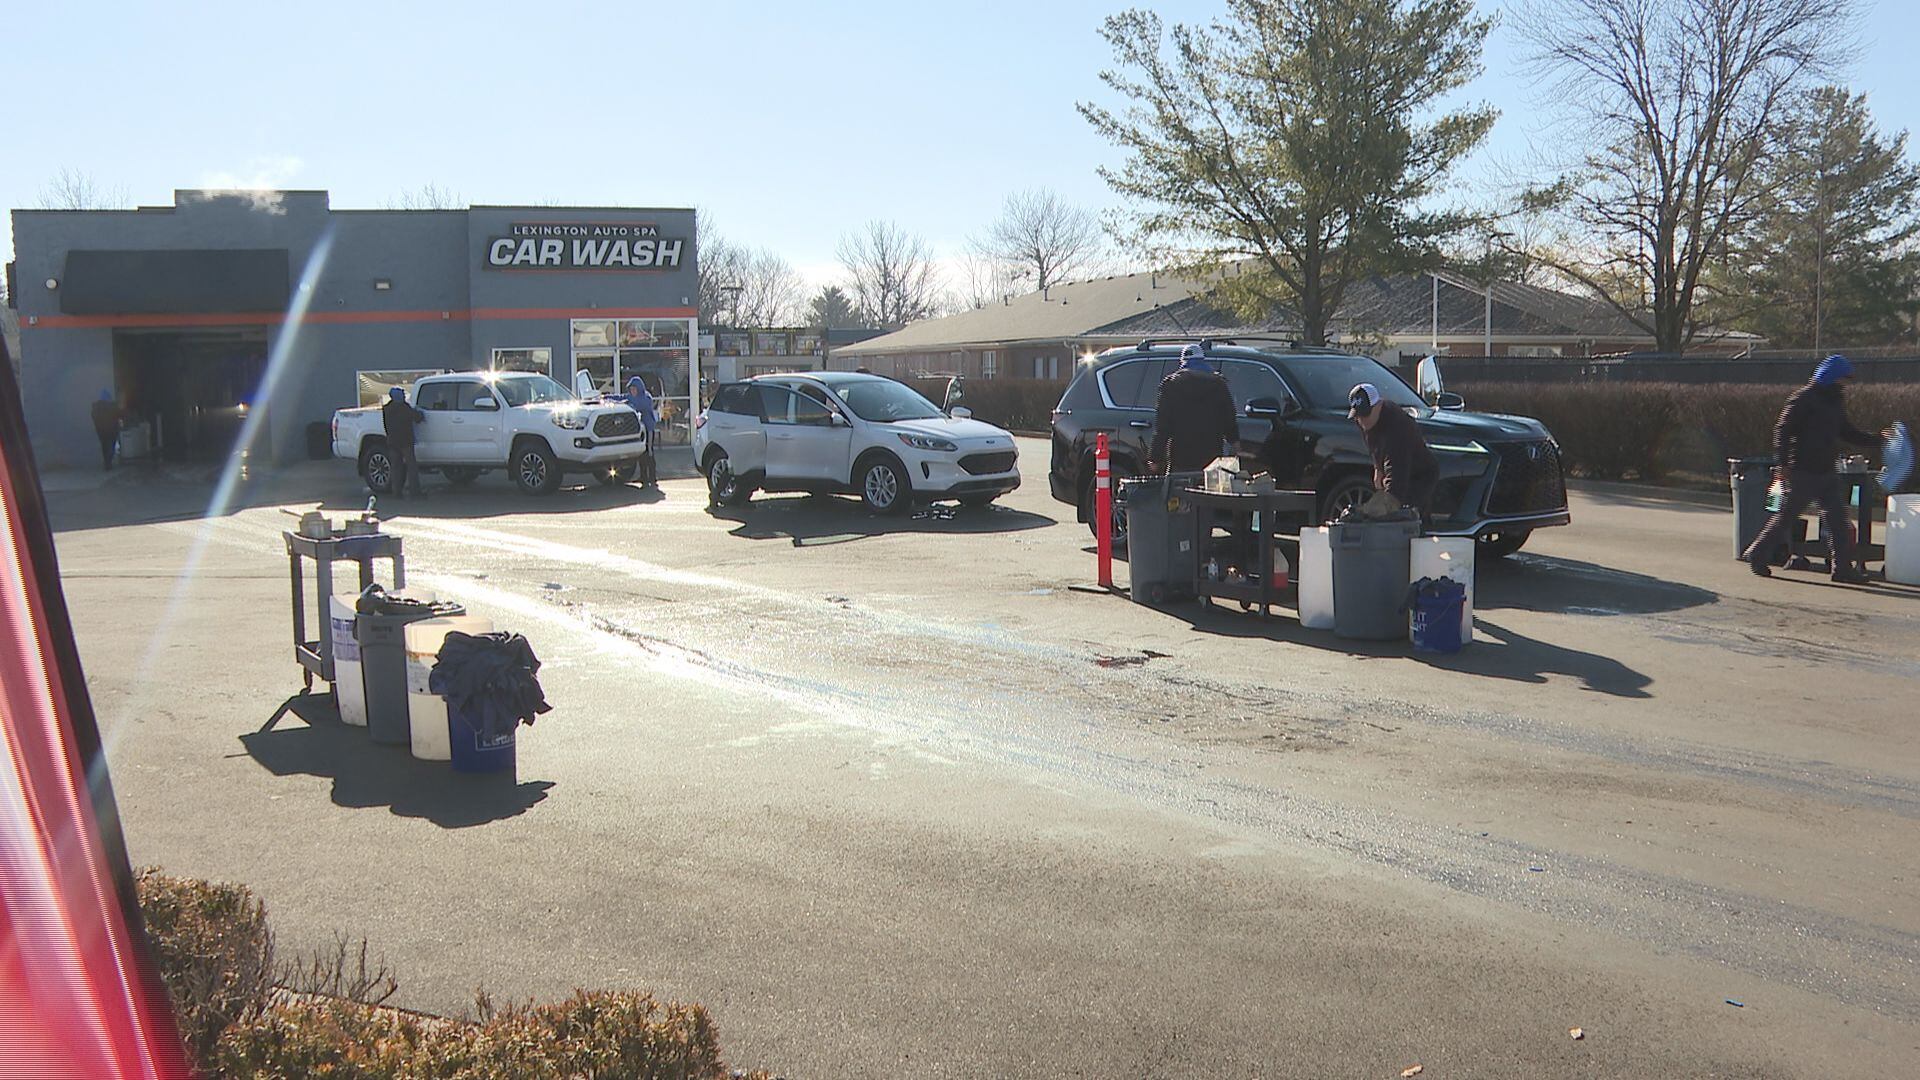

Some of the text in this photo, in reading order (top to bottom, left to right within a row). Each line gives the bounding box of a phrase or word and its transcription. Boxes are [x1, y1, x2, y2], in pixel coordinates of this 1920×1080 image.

[514, 226, 657, 236] LEXINGTON AUTO SPA
[489, 238, 682, 266] CAR WASH
